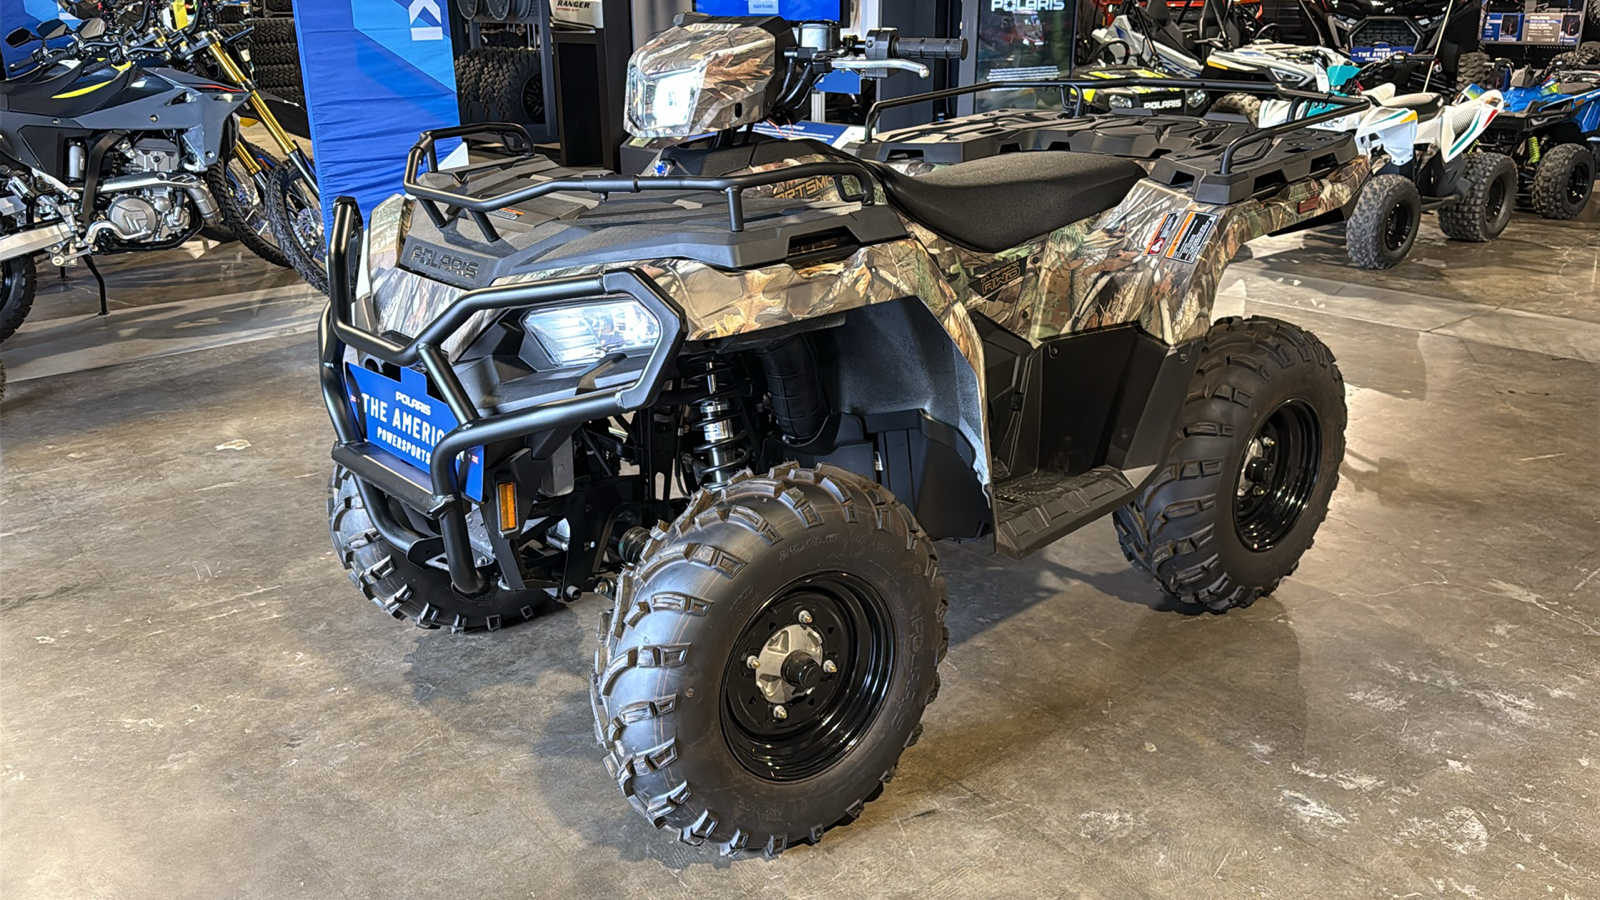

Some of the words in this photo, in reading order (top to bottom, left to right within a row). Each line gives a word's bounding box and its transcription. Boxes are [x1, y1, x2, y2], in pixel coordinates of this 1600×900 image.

[557, 0, 591, 9] RANGER
[991, 0, 1065, 11] POLARIS
[1143, 99, 1182, 109] POLARIS
[410, 244, 479, 279] POLARIS
[981, 266, 1021, 295] AWD
[361, 392, 389, 423] THE
[395, 390, 432, 416] POLARIS
[376, 426, 431, 466] POWERSPORTS
